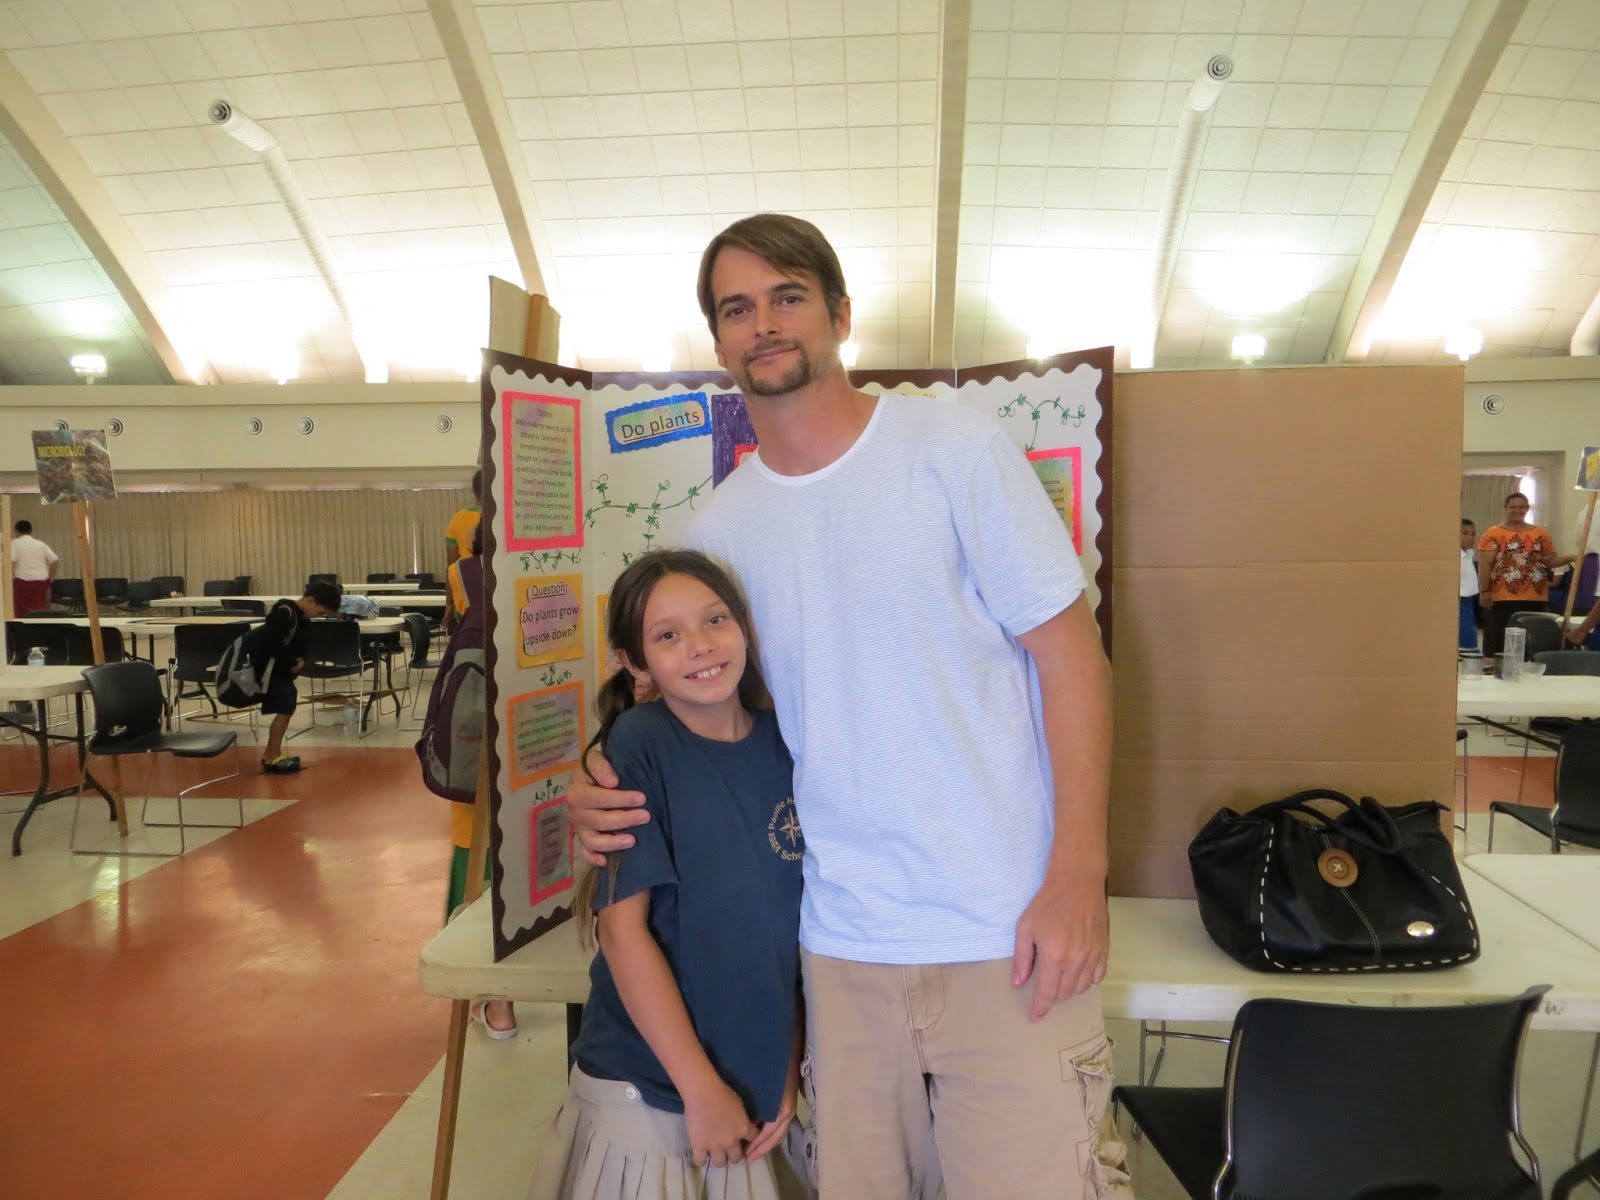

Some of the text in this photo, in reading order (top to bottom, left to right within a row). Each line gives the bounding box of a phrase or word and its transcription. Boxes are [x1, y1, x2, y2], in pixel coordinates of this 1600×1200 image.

[621, 410, 700, 439] Do plants
[532, 584, 568, 597] Question:
[522, 606, 579, 623] Do plants grow
[525, 624, 577, 647] upside down?
[768, 801, 786, 830] Pacific
